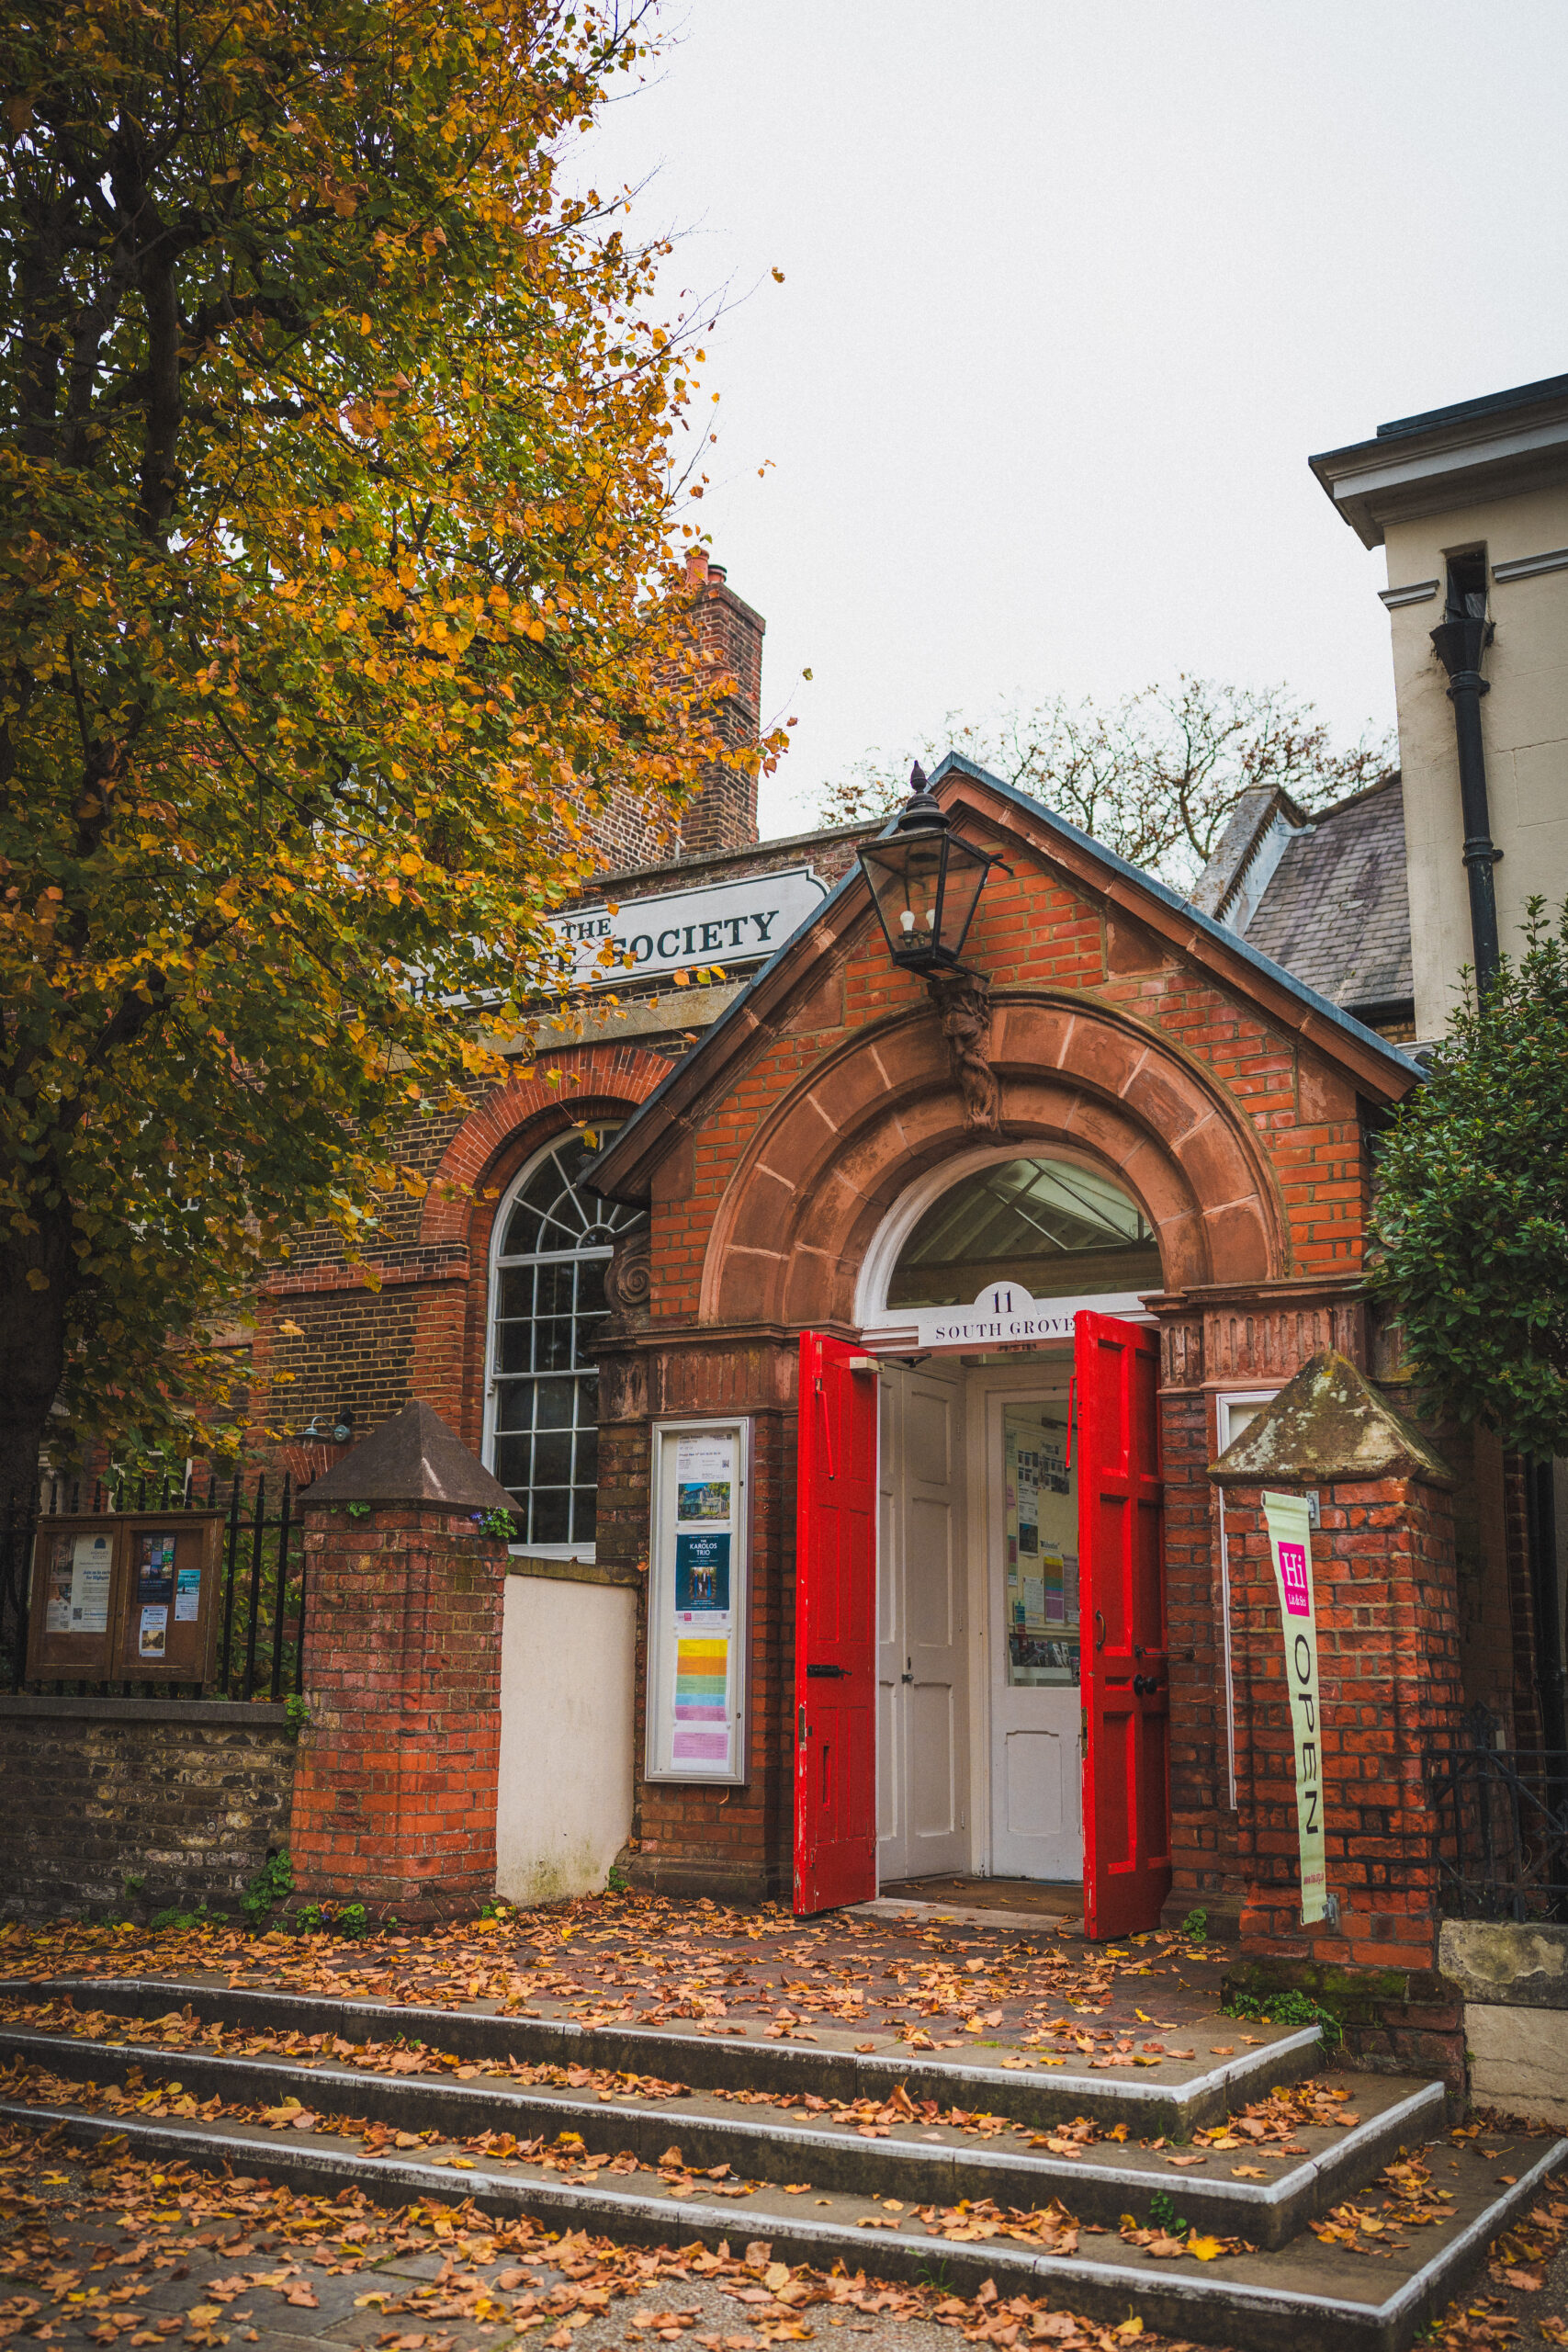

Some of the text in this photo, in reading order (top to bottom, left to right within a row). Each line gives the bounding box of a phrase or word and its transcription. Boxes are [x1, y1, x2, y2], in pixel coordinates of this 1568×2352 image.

[561, 917, 612, 943] THE
[609, 910, 780, 968] SOCIETY
[992, 1289, 1015, 1315] 11
[935, 1317, 1075, 1340] SOUTH GROVE
[1281, 1552, 1305, 1588] Hi
[1294, 1634, 1318, 1835] OPEN
